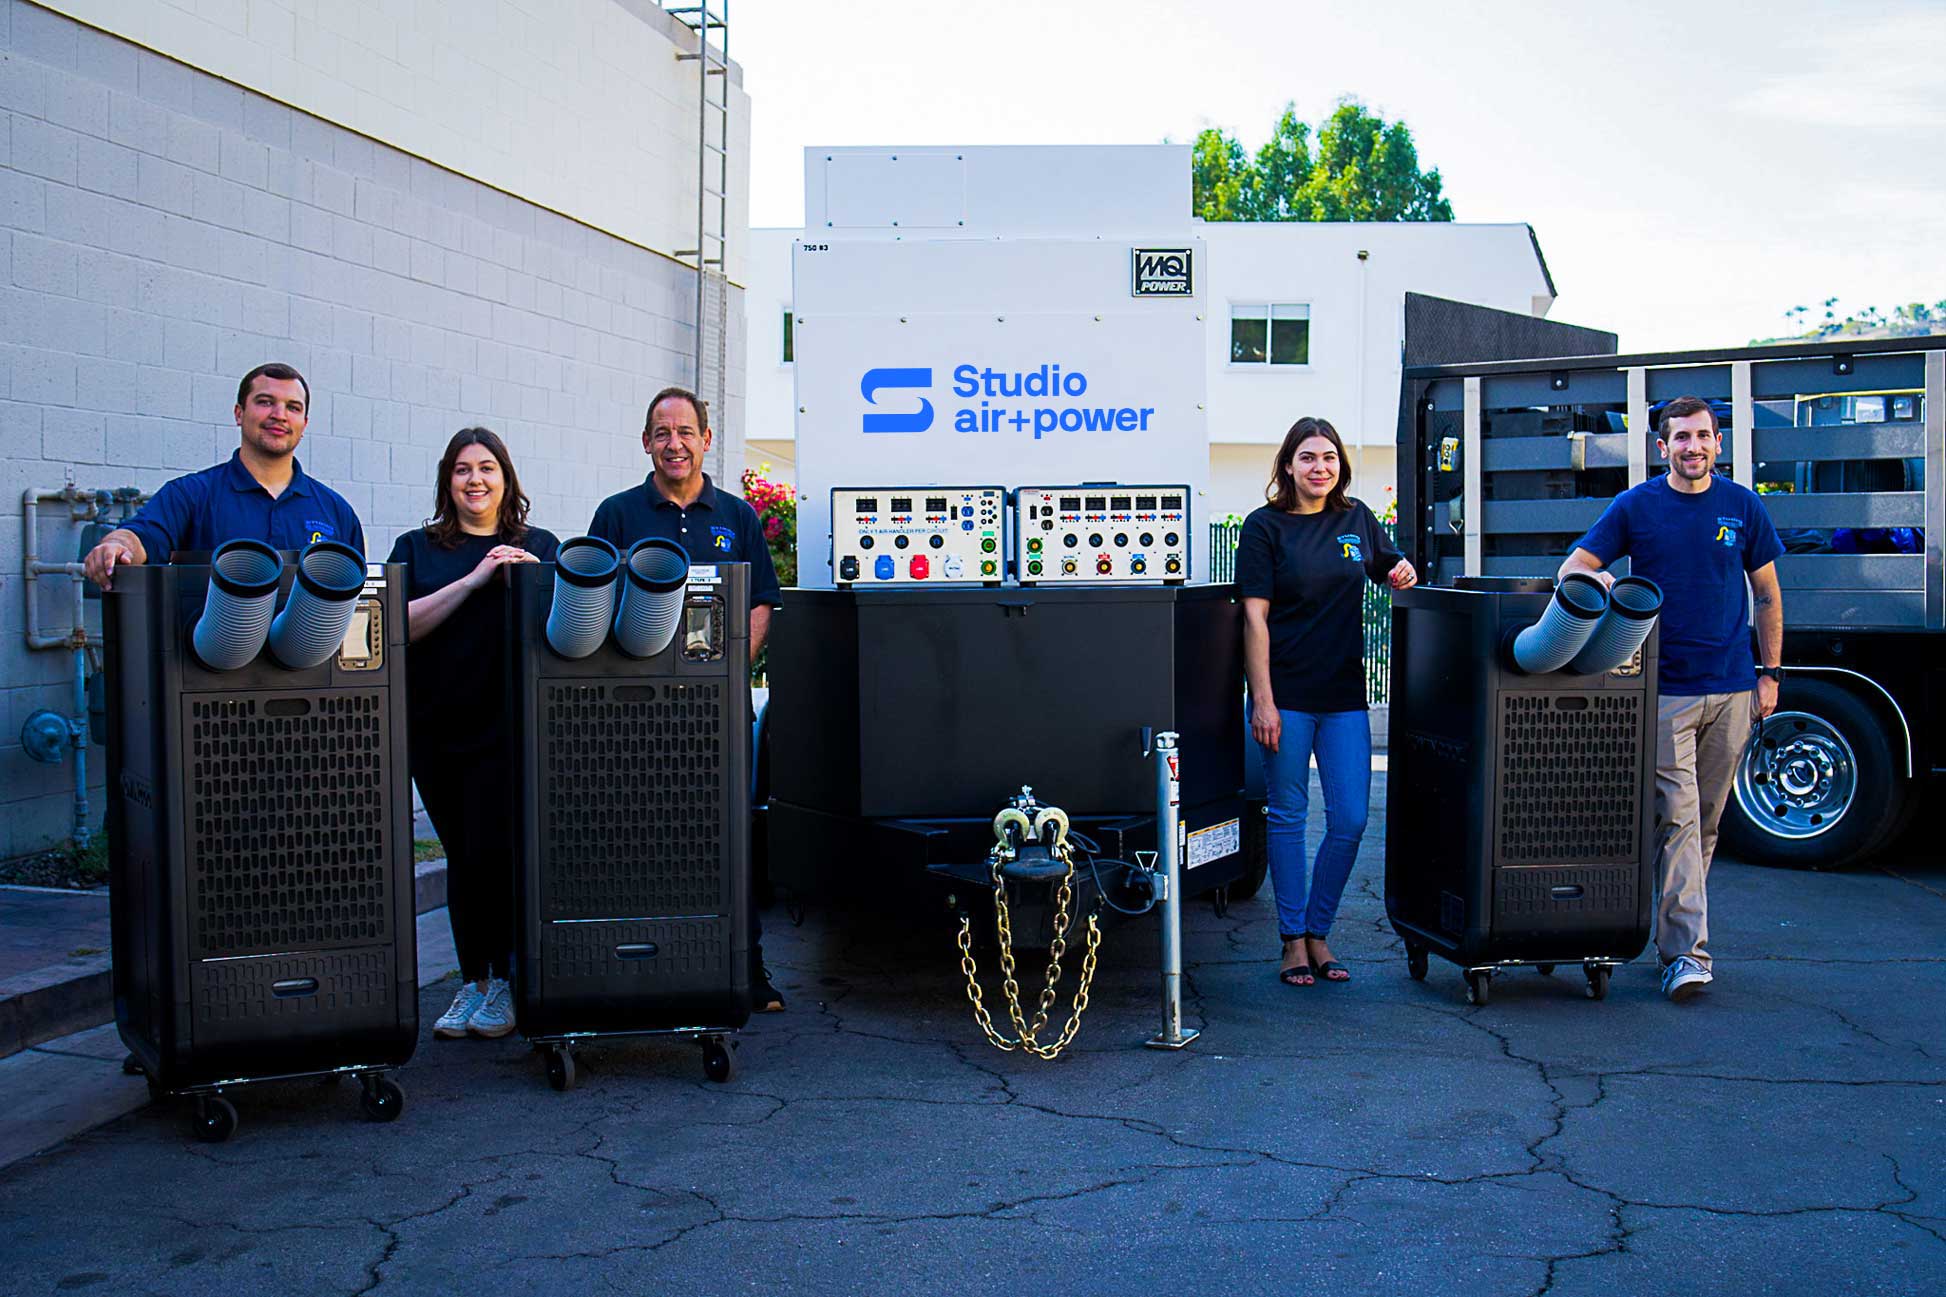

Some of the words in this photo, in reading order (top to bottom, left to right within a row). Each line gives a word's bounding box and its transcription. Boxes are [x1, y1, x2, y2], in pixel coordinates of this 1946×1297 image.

[1140, 255, 1187, 277] MQ
[1141, 281, 1187, 292] POWER
[953, 364, 1087, 397] Studio
[954, 401, 1154, 439] air+power
